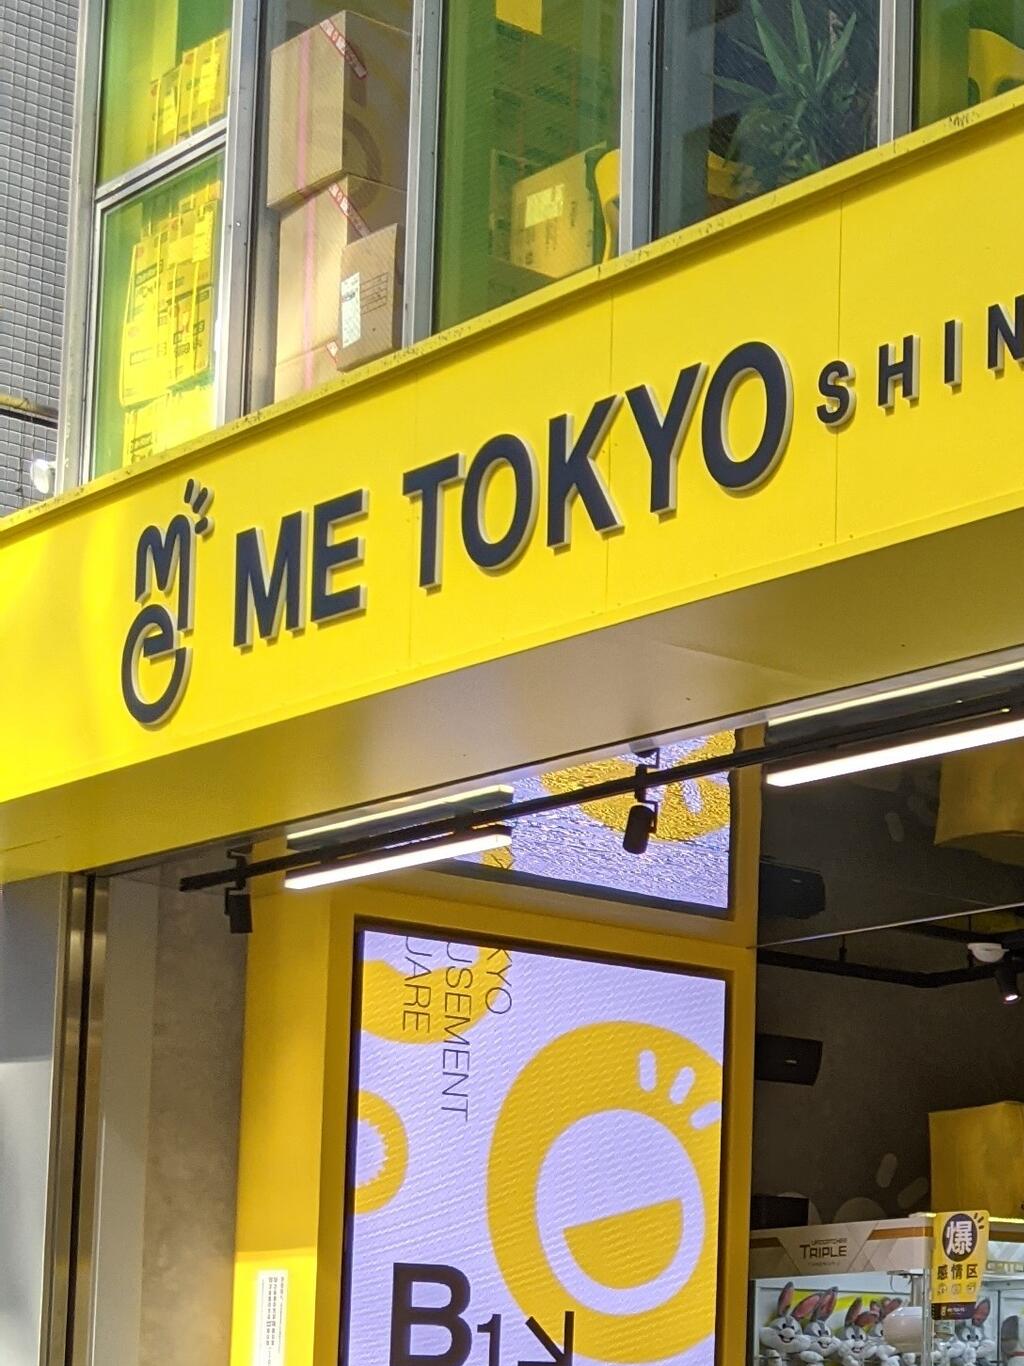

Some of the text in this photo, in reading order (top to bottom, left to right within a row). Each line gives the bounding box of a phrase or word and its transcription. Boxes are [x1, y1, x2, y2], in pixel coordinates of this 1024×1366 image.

[233, 488, 369, 655] ME
[402, 340, 793, 592] TOKYO
[800, 1243, 848, 1259] TRIPLE
